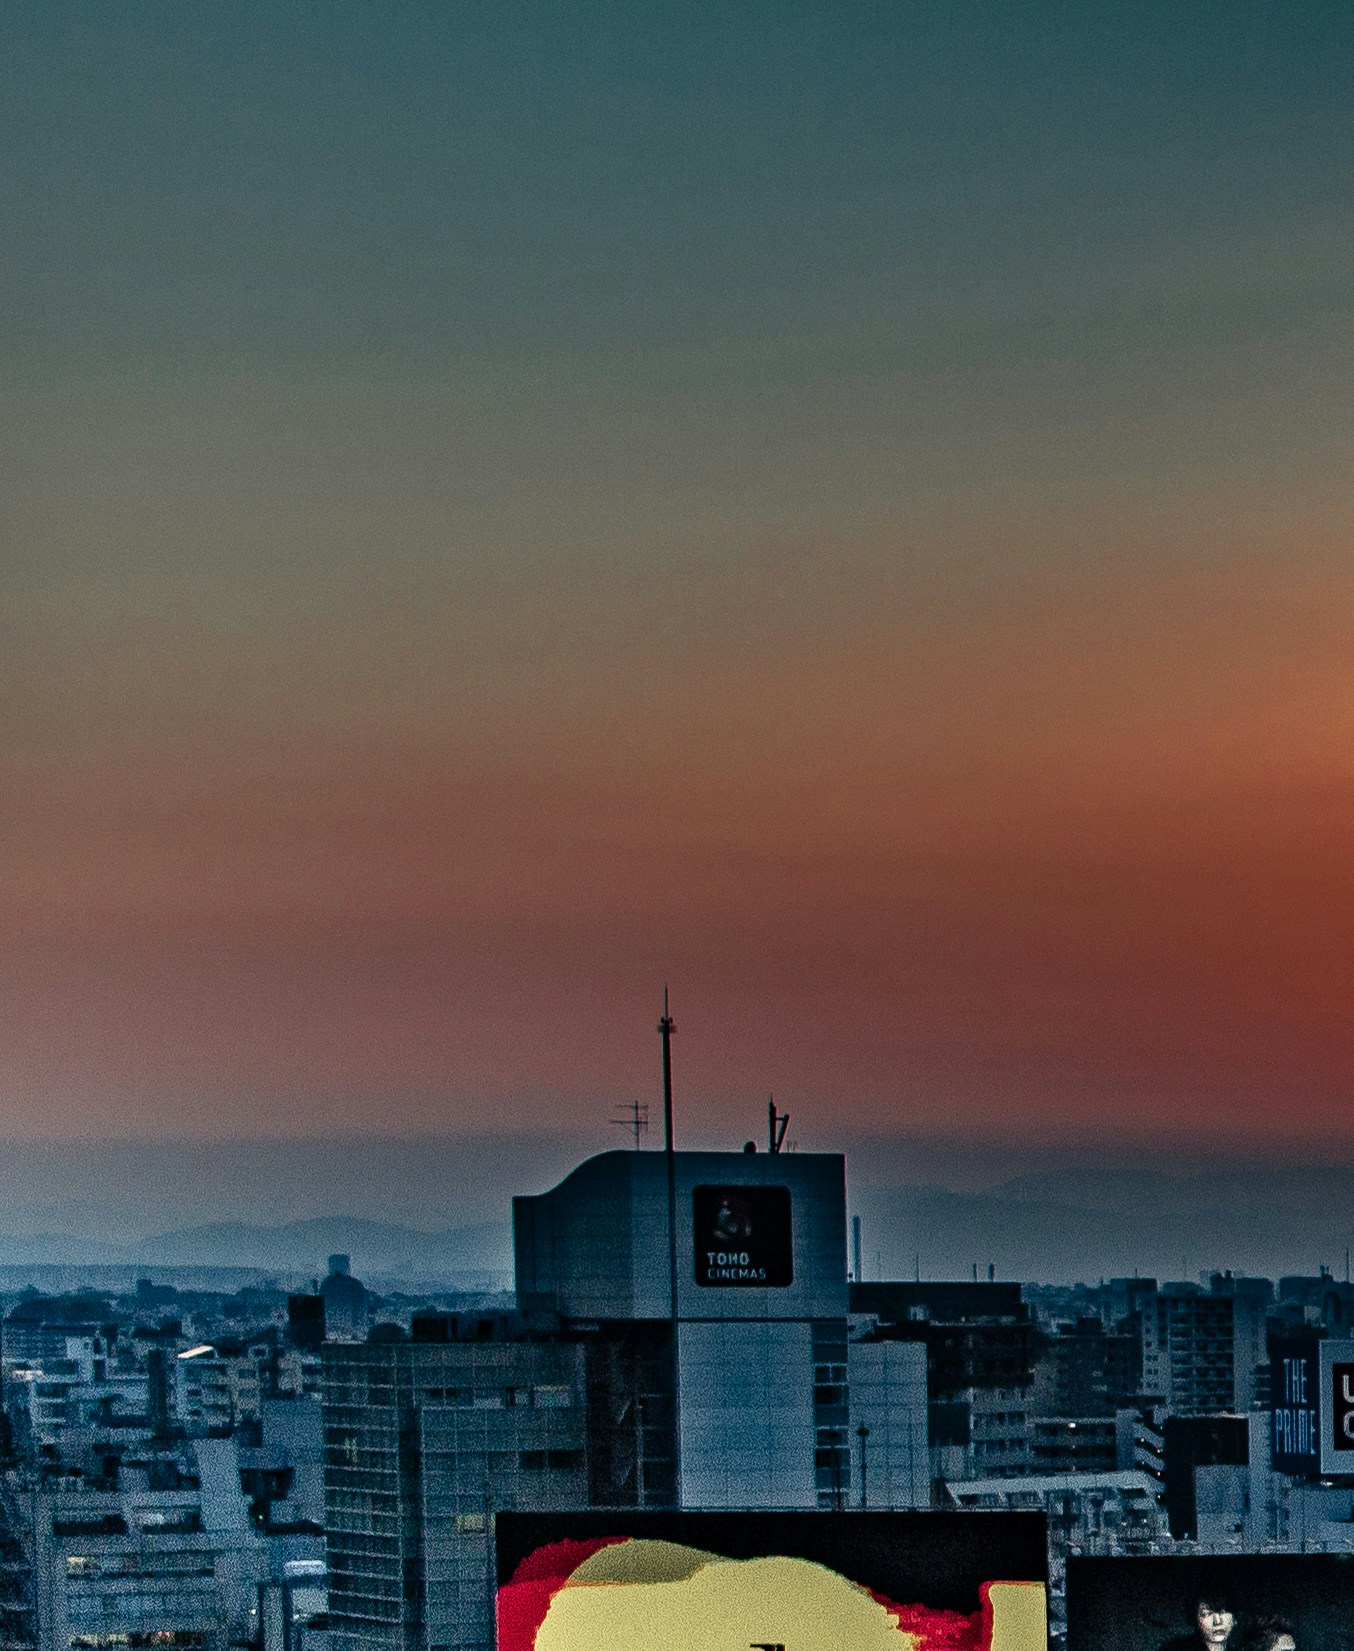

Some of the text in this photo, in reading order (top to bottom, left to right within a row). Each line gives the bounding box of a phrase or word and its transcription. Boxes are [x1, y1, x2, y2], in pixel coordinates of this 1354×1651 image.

[707, 1252, 750, 1265] TOHO
[708, 1267, 766, 1280] CINEMAS
[1283, 1358, 1307, 1403] THE
[1275, 1409, 1317, 1456] PRIME
